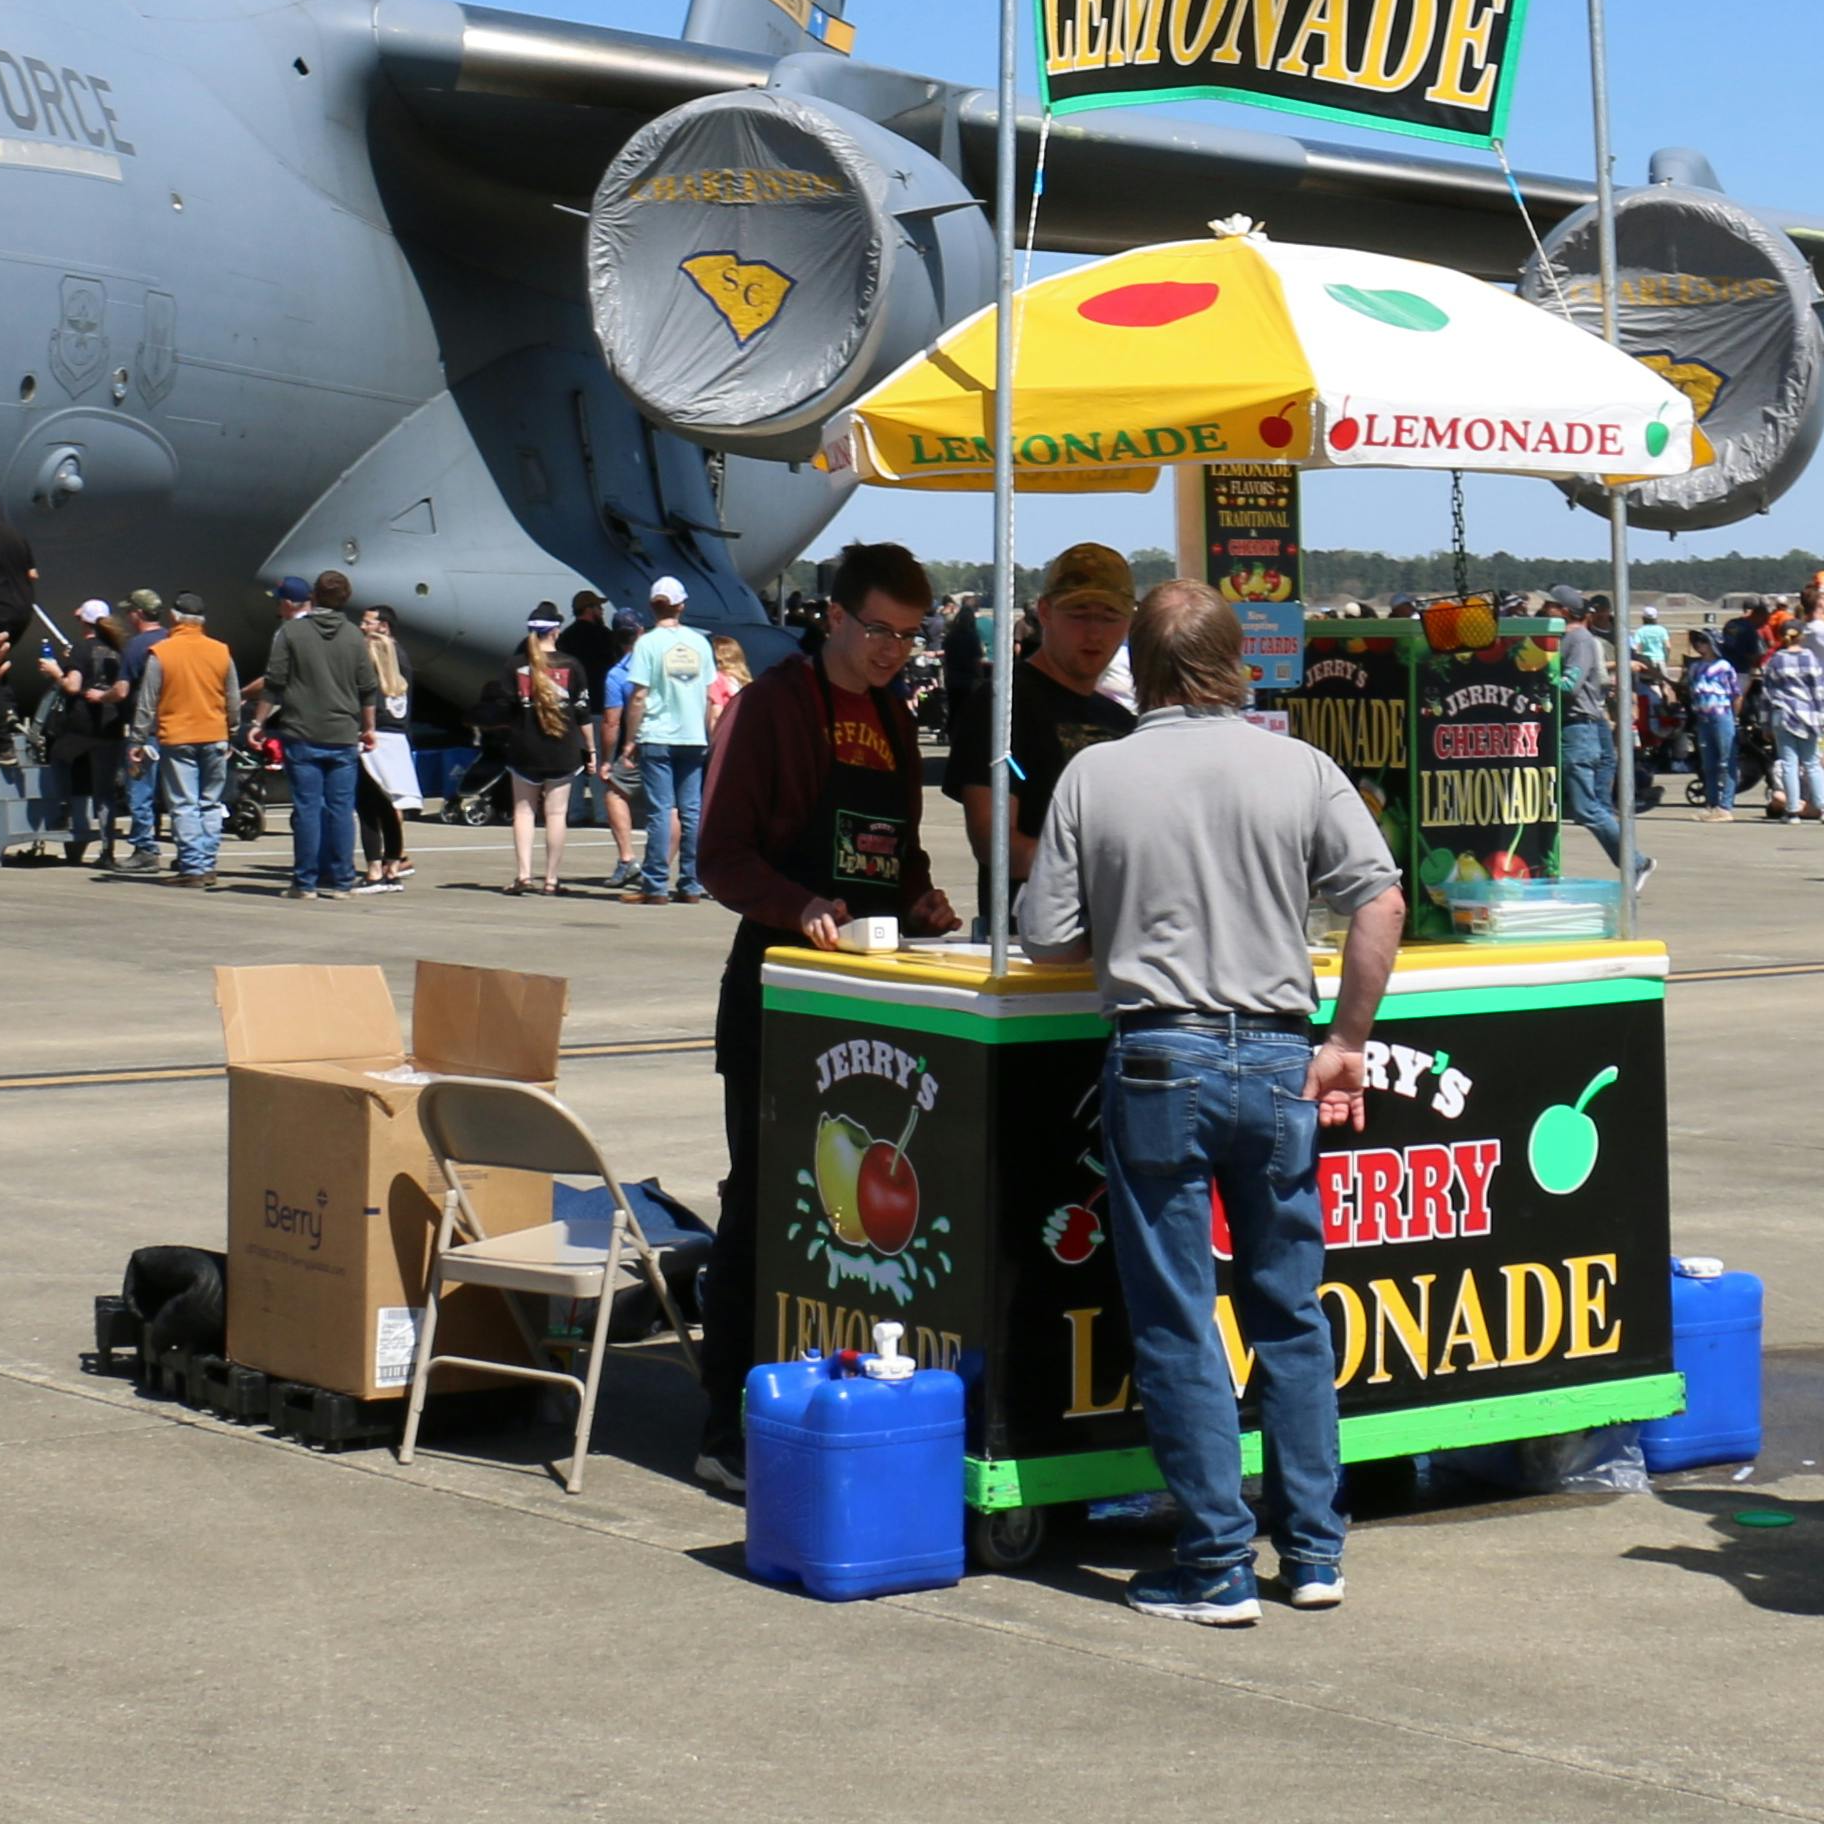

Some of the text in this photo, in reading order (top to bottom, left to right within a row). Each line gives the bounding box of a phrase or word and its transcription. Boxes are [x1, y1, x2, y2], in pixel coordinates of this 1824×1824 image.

[1363, 414, 1625, 456] LEMONADE
[1210, 463, 1293, 477] LEMONADE
[1230, 480, 1276, 495] FLAVORS
[1218, 510, 1290, 528] TRADITIONAL
[1260, 637, 1298, 656] CARDS
[1306, 659, 1368, 689] JERRY'S
[1445, 684, 1529, 717] JERRY'S
[1275, 697, 1407, 768] EMONADE
[1433, 722, 1542, 759] CHERRY
[1421, 766, 1557, 827] LEMONADE
[816, 1039, 938, 1111] JERRY'S
[1362, 1040, 1473, 1118] RY'S
[1211, 1138, 1502, 1261] ERRY
[263, 1189, 323, 1251] Berry
